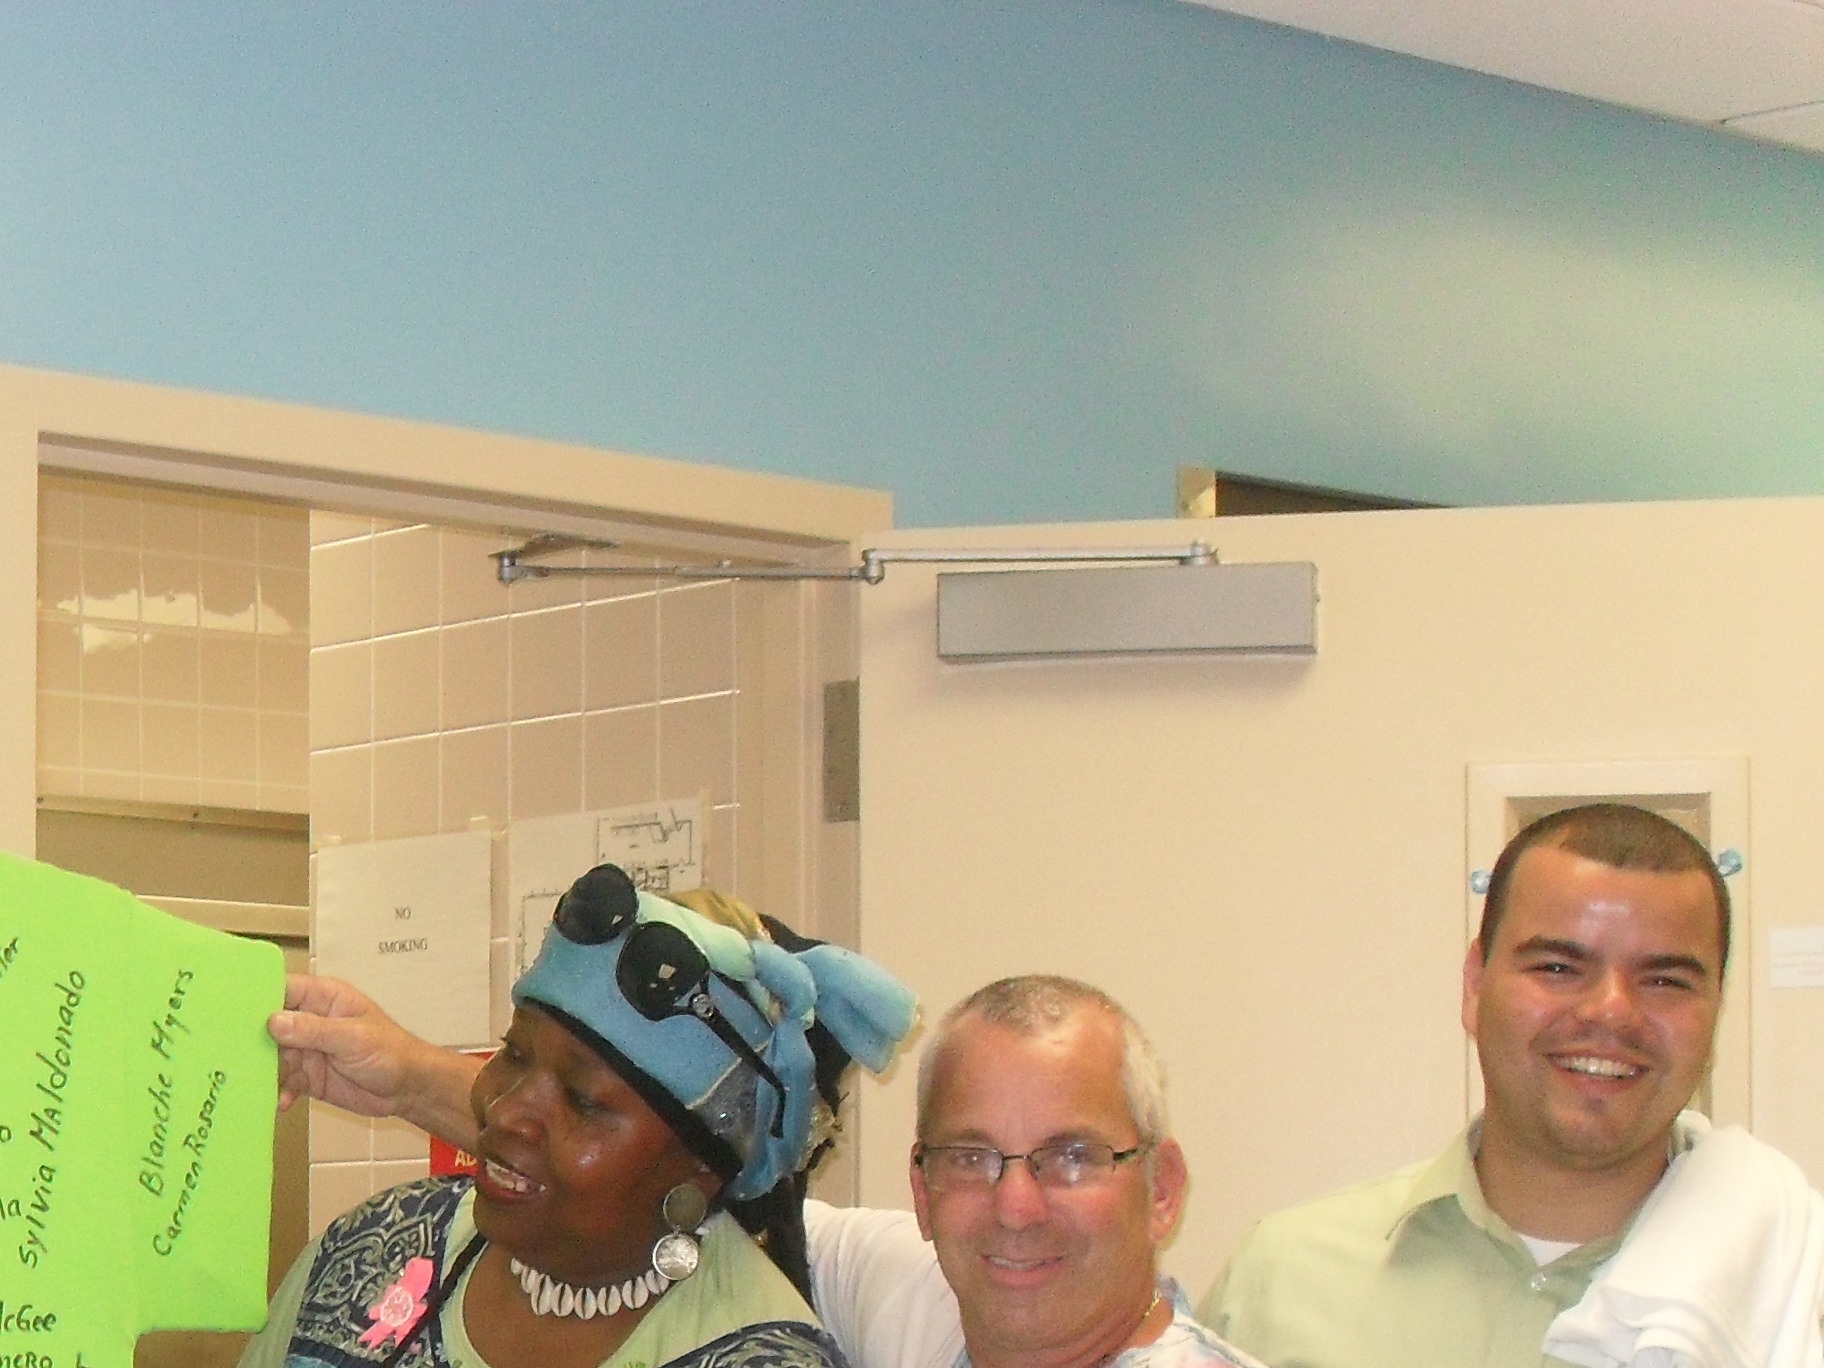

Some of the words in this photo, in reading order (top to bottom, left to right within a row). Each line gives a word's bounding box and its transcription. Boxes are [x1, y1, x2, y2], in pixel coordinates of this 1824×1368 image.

[395, 907, 411, 919] NO
[378, 938, 428, 953] SMOKING
[138, 1073, 175, 1200] Blanche
[152, 1144, 203, 1258] Carmen
